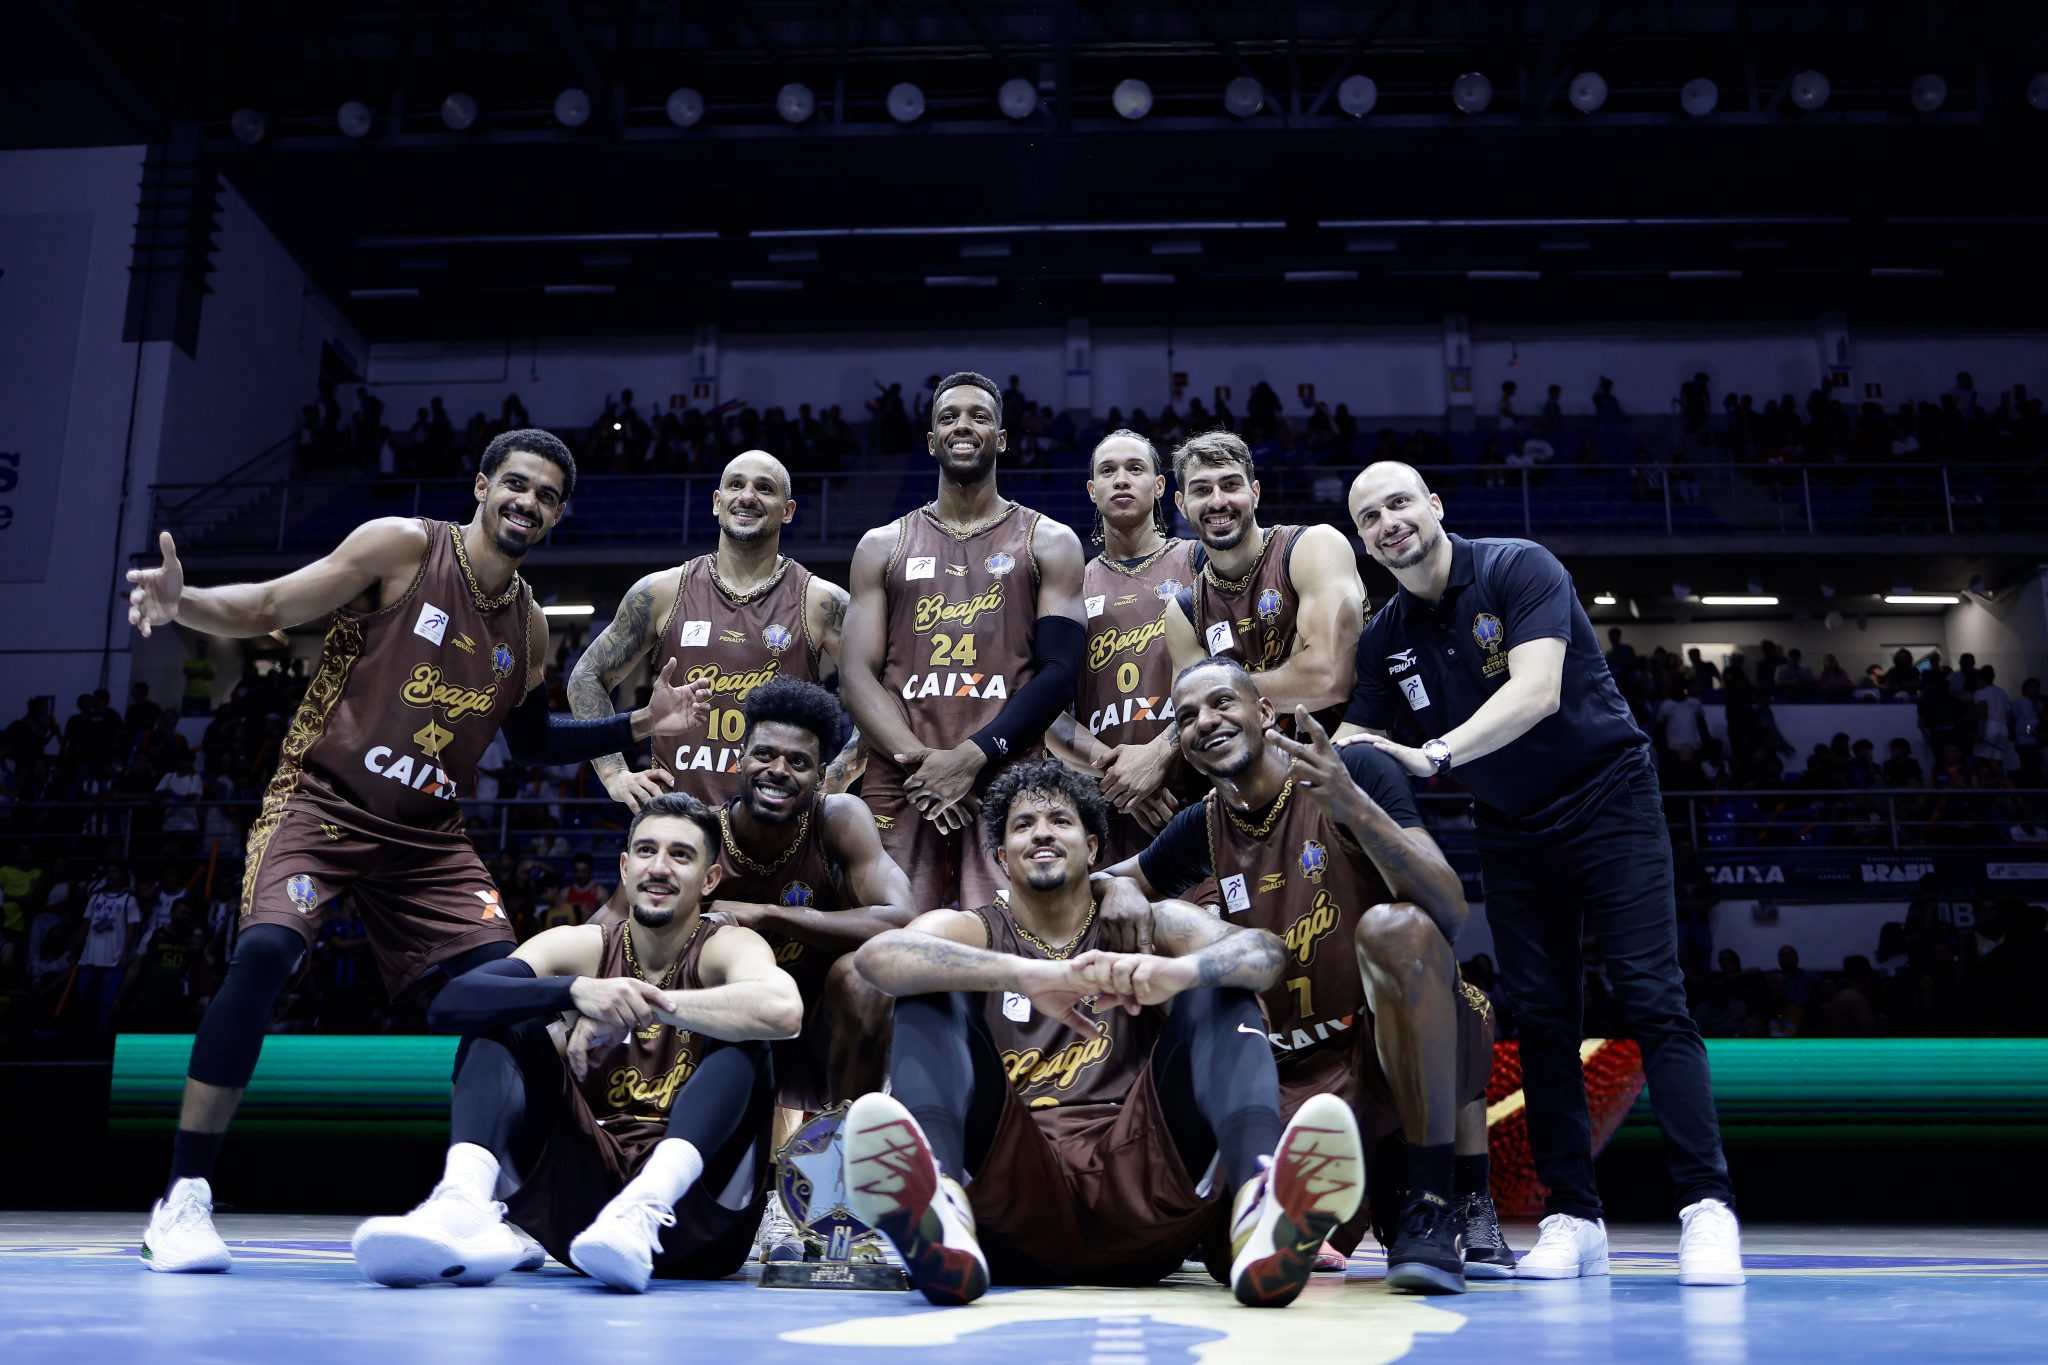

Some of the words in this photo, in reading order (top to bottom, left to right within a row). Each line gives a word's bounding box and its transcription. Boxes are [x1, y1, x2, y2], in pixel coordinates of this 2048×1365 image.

[916, 584, 1002, 631] Beagá
[929, 633, 977, 667] 24
[403, 666, 497, 718] Beagá
[902, 672, 1008, 700] CAIXA
[1117, 662, 1140, 693] 0
[707, 708, 746, 742] 10
[1259, 879, 1286, 894] PENALTY
[1286, 976, 1315, 1018] 7
